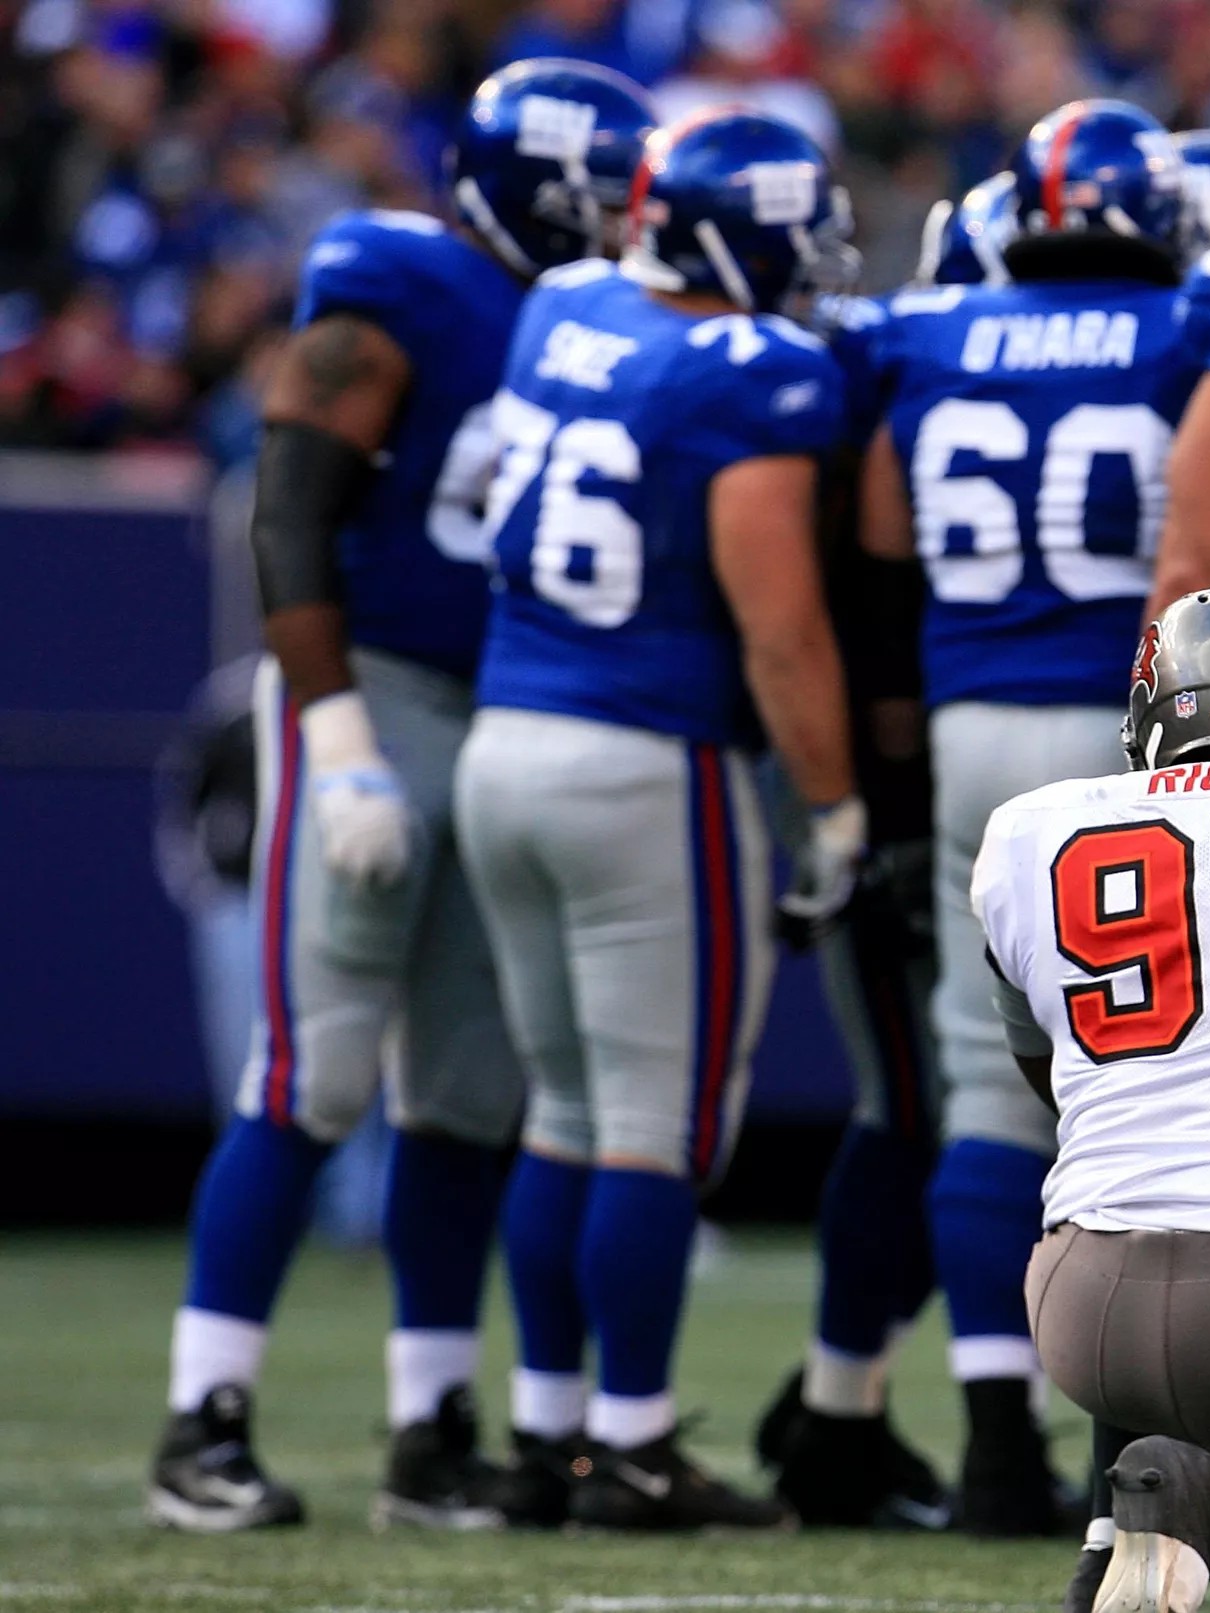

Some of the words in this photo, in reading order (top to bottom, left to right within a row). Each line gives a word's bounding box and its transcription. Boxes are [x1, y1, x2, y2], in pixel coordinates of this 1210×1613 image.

[961, 309, 1140, 374] O'HARA
[486, 386, 644, 629] 76
[912, 397, 1173, 604] 60
